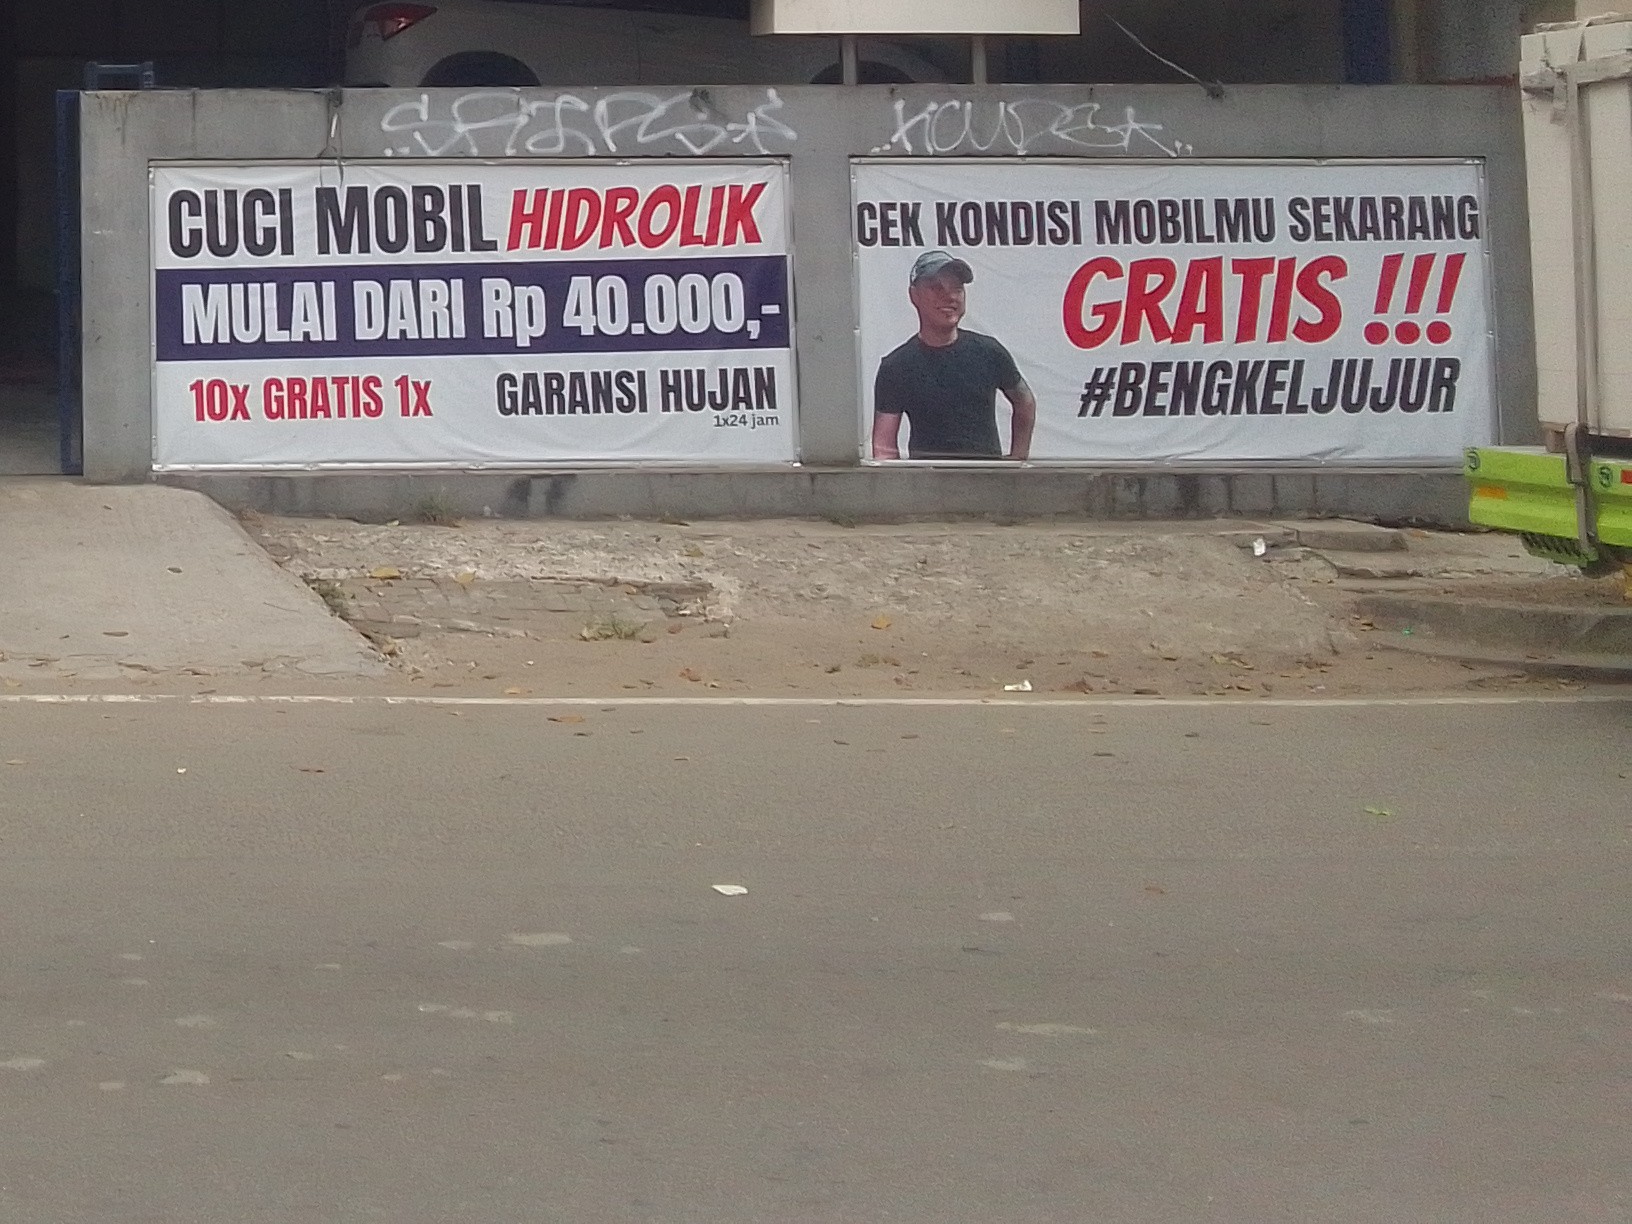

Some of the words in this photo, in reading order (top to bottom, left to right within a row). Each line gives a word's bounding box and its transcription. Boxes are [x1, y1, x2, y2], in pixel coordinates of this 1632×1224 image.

[168, 187, 295, 258] CUCI
[316, 184, 498, 255] MOBIL
[506, 181, 768, 252] HIDROLIK
[857, 201, 924, 247] CEK
[936, 200, 1082, 246] KONDISI
[1095, 197, 1275, 245] MOBILMU
[1288, 195, 1480, 243] SEKARANG
[181, 280, 337, 345] MULAI
[354, 278, 465, 341] DARI
[482, 277, 546, 347] Rp
[563, 272, 780, 341] 40.000,-
[1062, 251, 1348, 350] GRATIS
[188, 378, 251, 422] 10x
[263, 376, 383, 421] GRATIS
[394, 374, 432, 419] 1x
[496, 371, 647, 417] GARANSI
[660, 366, 777, 413] HUJAN
[1076, 358, 1461, 418] #BENGKELJUJUR
[714, 414, 747, 428] 1x24
[750, 413, 780, 430] jam
